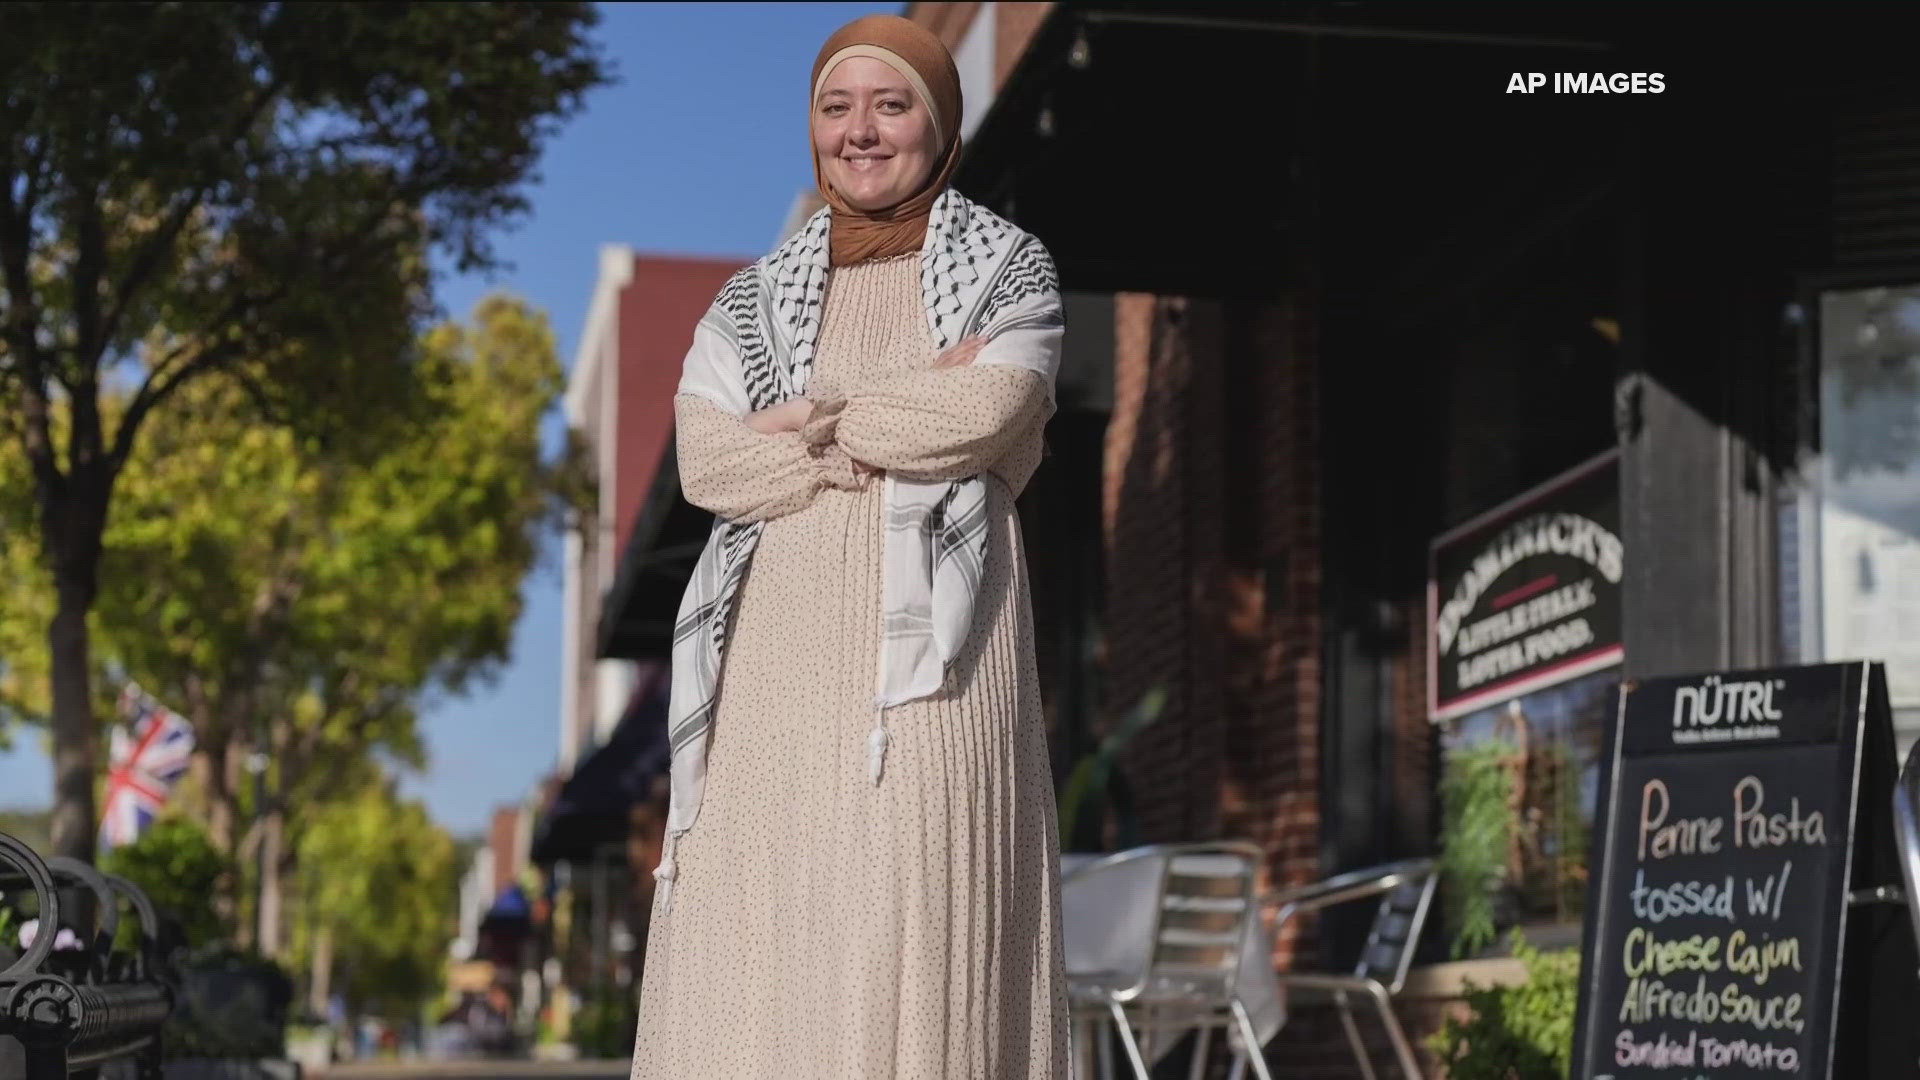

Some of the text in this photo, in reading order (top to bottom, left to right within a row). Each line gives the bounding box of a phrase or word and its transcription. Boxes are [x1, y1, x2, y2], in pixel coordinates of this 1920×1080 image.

[1437, 514, 1624, 657] DOMINICK'S
[1458, 603, 1528, 656] LITTLE
[1457, 640, 1525, 689] LOTTA
[1637, 776, 1826, 861] Penne Pasta
[1630, 868, 1735, 923] tossed
[1623, 927, 1802, 985] Cheese Cajun
[1619, 974, 1719, 1023] Alfredo
